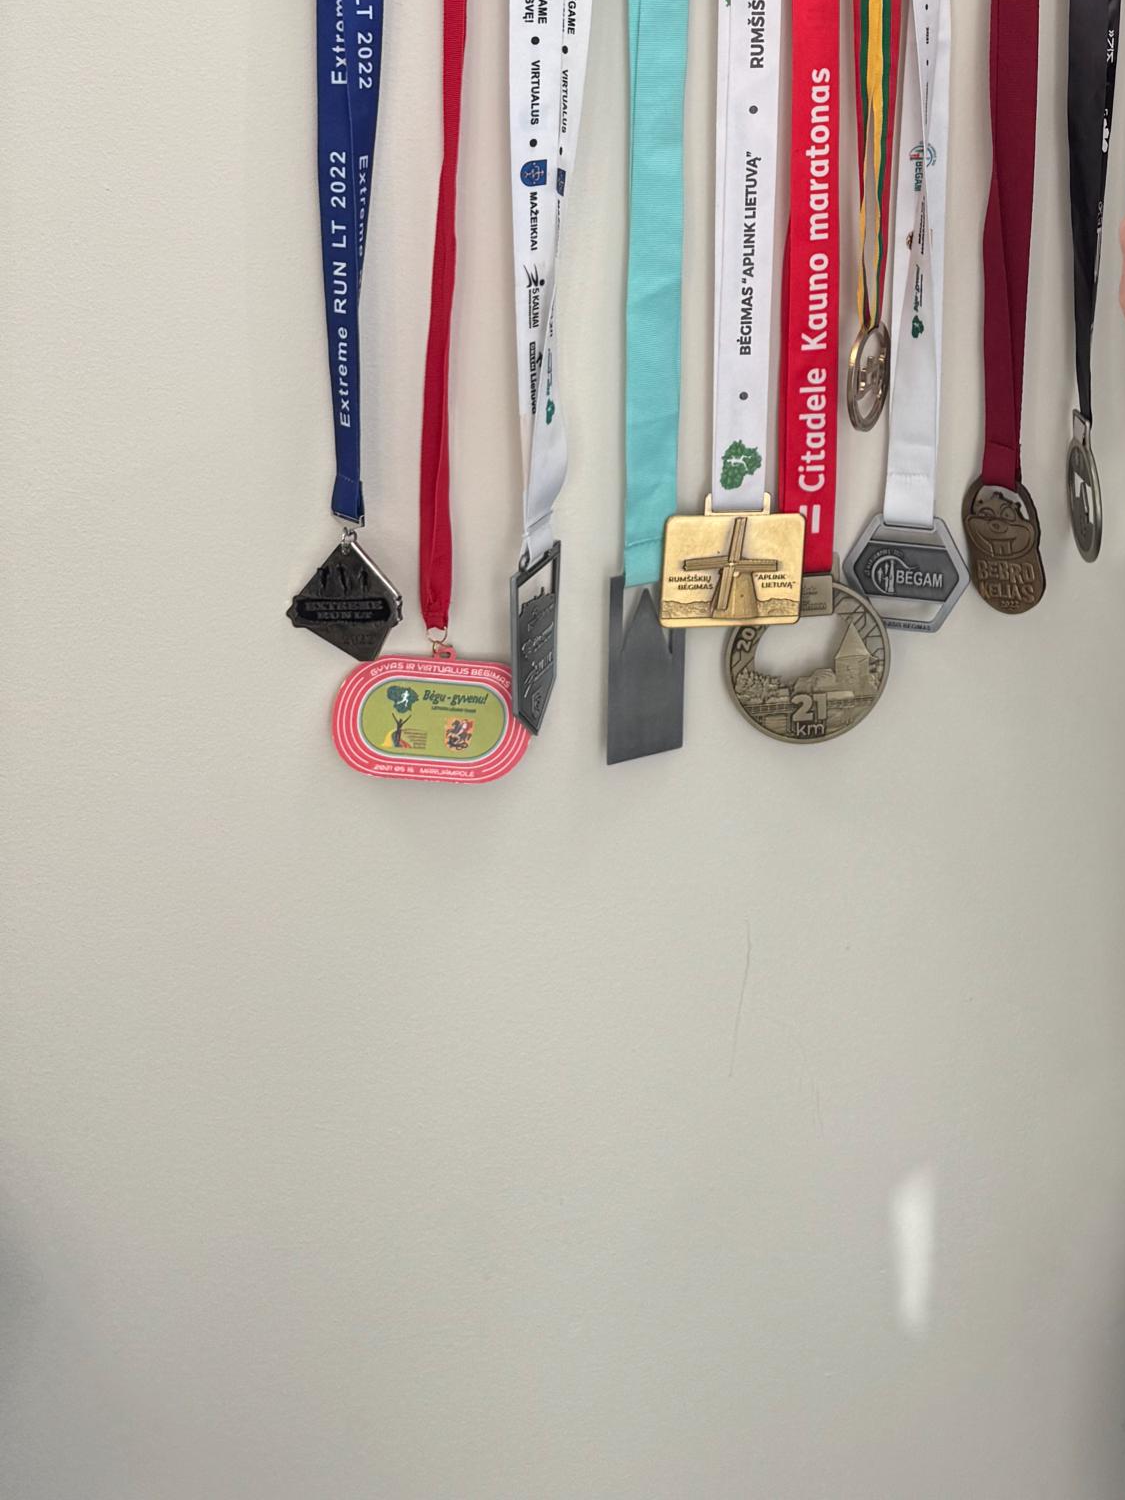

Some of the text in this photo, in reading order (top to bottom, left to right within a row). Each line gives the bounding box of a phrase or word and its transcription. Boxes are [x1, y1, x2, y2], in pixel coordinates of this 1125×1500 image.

[357, 32, 374, 90] 2022
[530, 59, 541, 126] VIRTUALUS
[560, 69, 569, 134] VIRTUALUS
[529, 192, 539, 251] MAŽEIKIAI
[330, 150, 351, 429] Extreme RUN LT 2022
[798, 67, 831, 493] Citadele Kauno maratonas
[736, 287, 755, 356] BĖGIMAS
[977, 560, 1035, 584] BEBRO
[980, 581, 1035, 604] KELIAS
[305, 601, 384, 611] EXTREME
[370, 661, 404, 677] GYVAS
[405, 663, 416, 671] IR
[417, 664, 470, 676] VIRTUALUS
[422, 689, 446, 705] Bėgu
[450, 693, 489, 706] gyvenu!
[790, 693, 828, 722] 21
[795, 722, 825, 737] km
